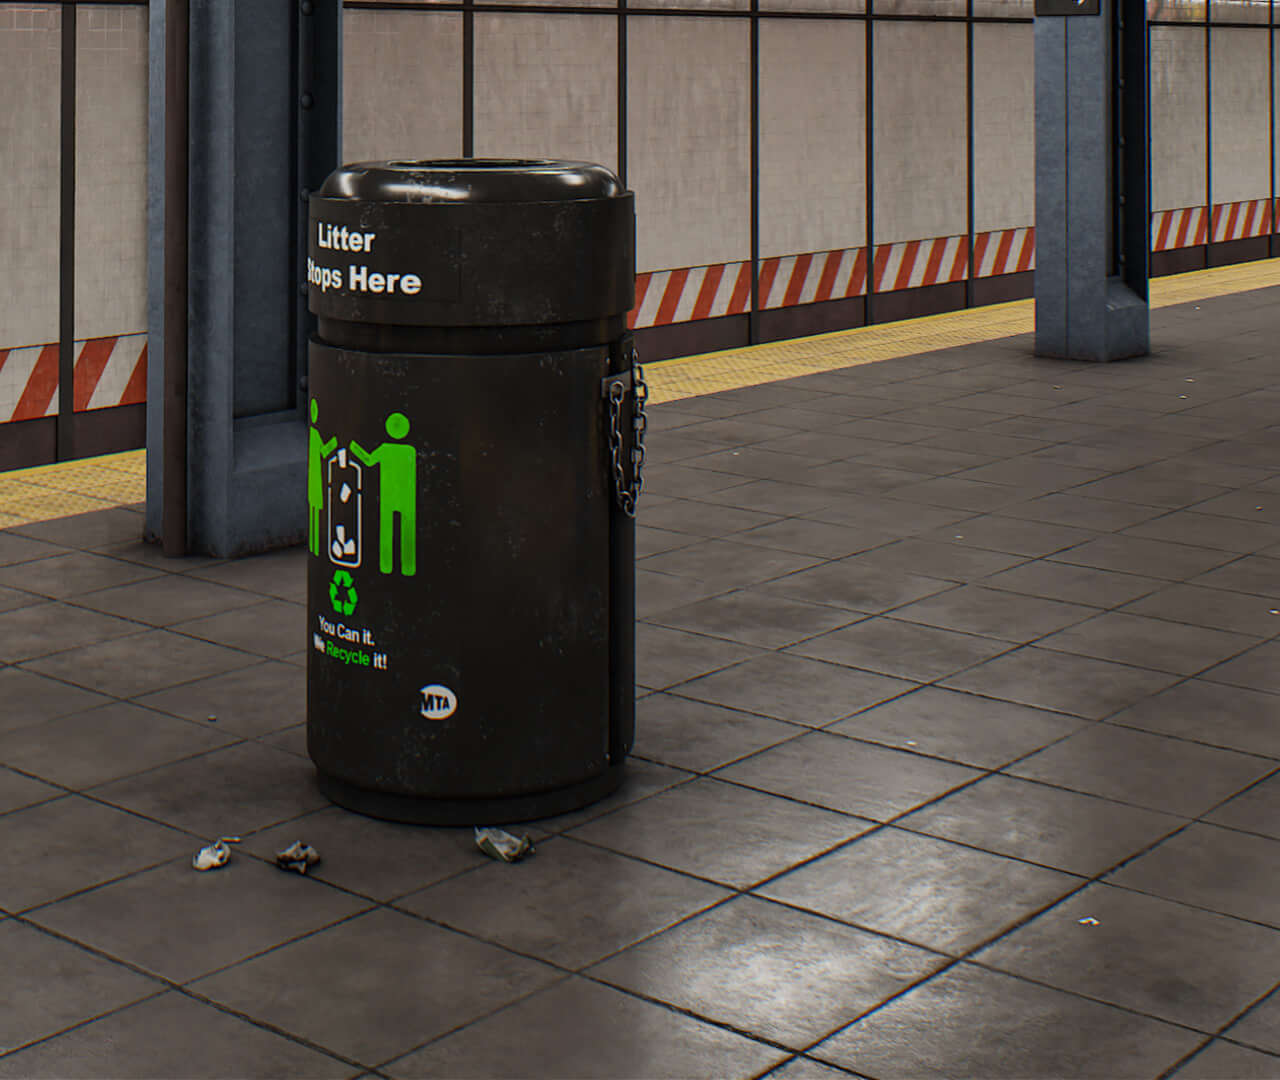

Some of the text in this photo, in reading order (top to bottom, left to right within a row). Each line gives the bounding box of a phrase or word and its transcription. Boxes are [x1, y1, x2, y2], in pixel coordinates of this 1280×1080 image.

[318, 221, 376, 253] Litter
[349, 264, 423, 296] Here
[319, 615, 335, 637] You
[337, 622, 361, 644] Can
[326, 640, 370, 667] Recycle
[373, 651, 389, 671] it!
